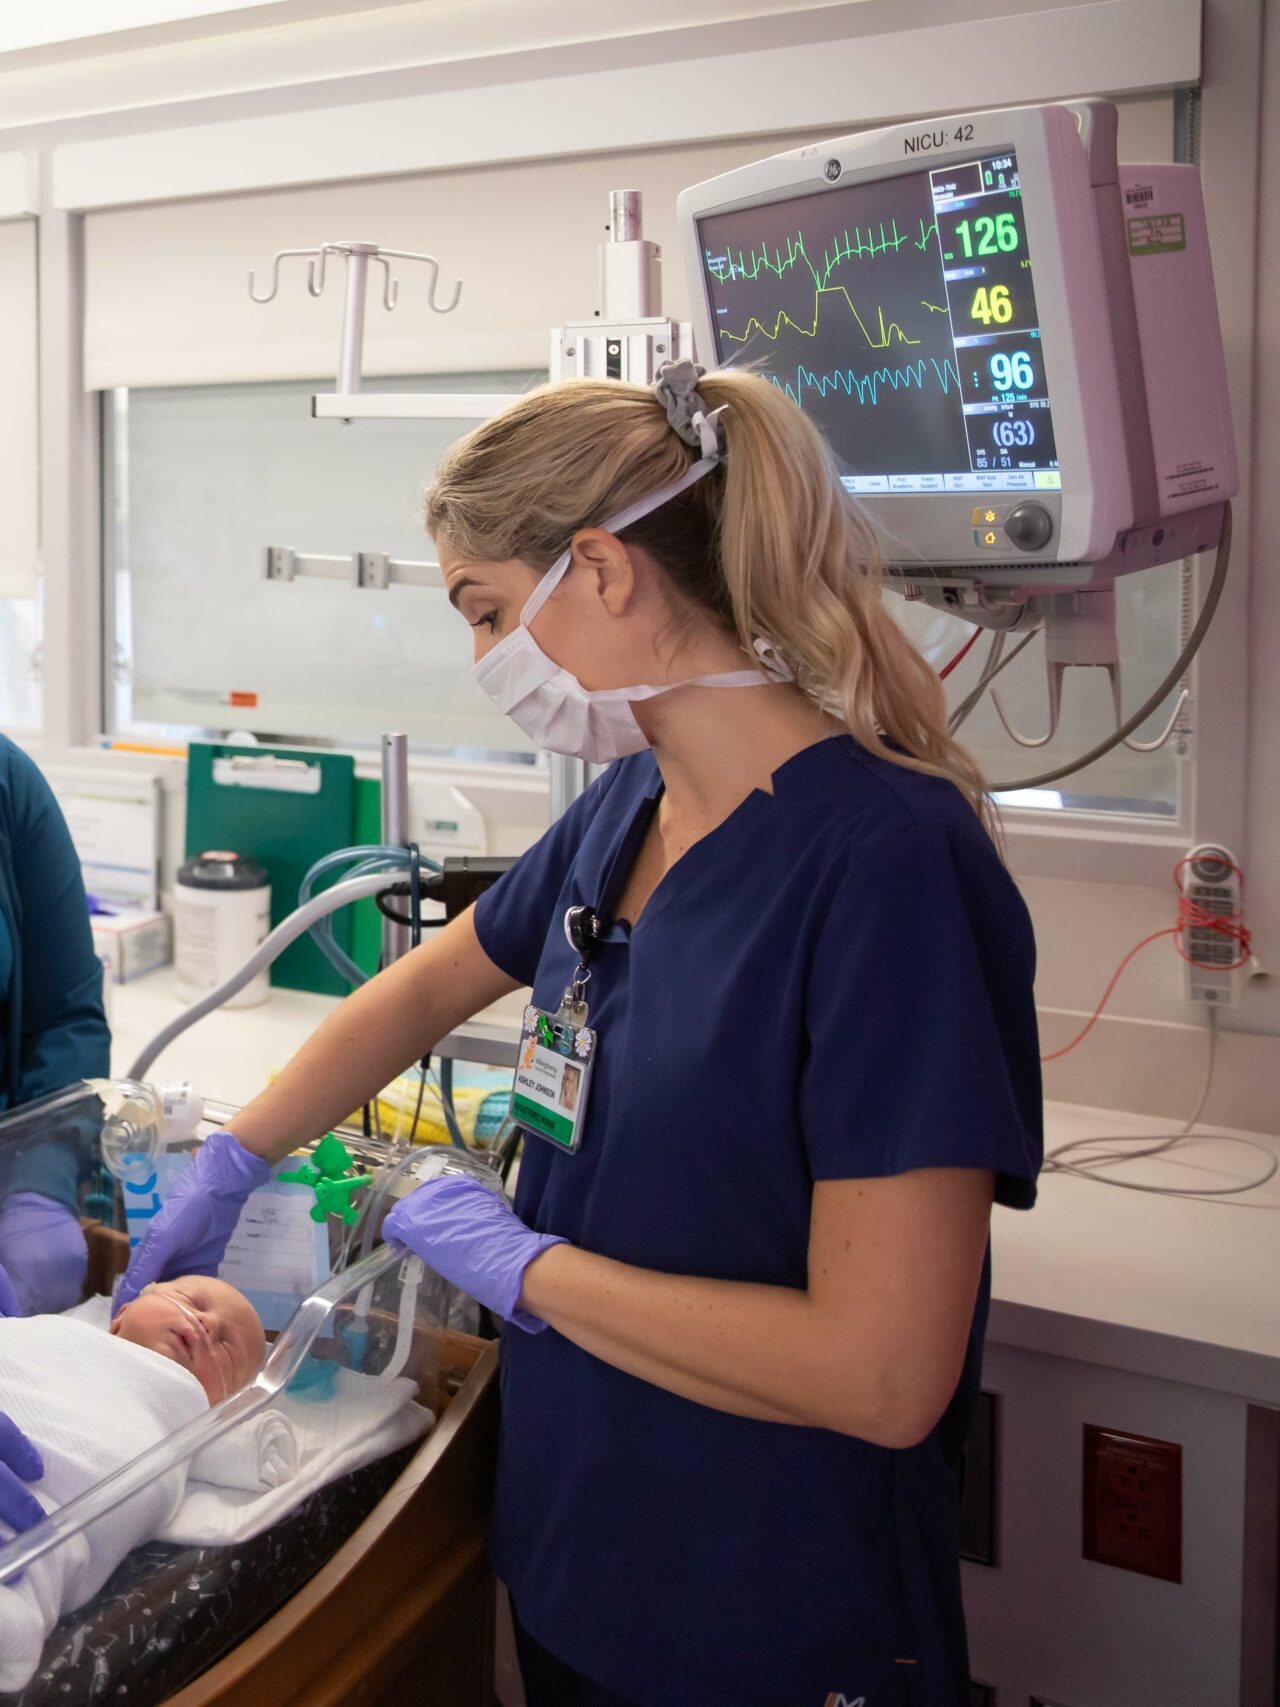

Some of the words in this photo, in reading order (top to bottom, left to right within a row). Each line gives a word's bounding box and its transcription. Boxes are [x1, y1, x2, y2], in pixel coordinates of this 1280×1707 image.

[904, 131, 949, 154] NICU:
[954, 124, 974, 142] 42
[992, 158, 1012, 170] 10:34
[955, 212, 1019, 258] 126
[971, 284, 1013, 325] 46
[990, 351, 1034, 391] 96
[1001, 393, 1016, 403] 125
[992, 420, 1035, 447] (63)
[976, 457, 988, 468] 85
[1001, 456, 1012, 468] 51
[518, 1074, 535, 1090] ASHLEY
[534, 1082, 556, 1099] JOHNSON
